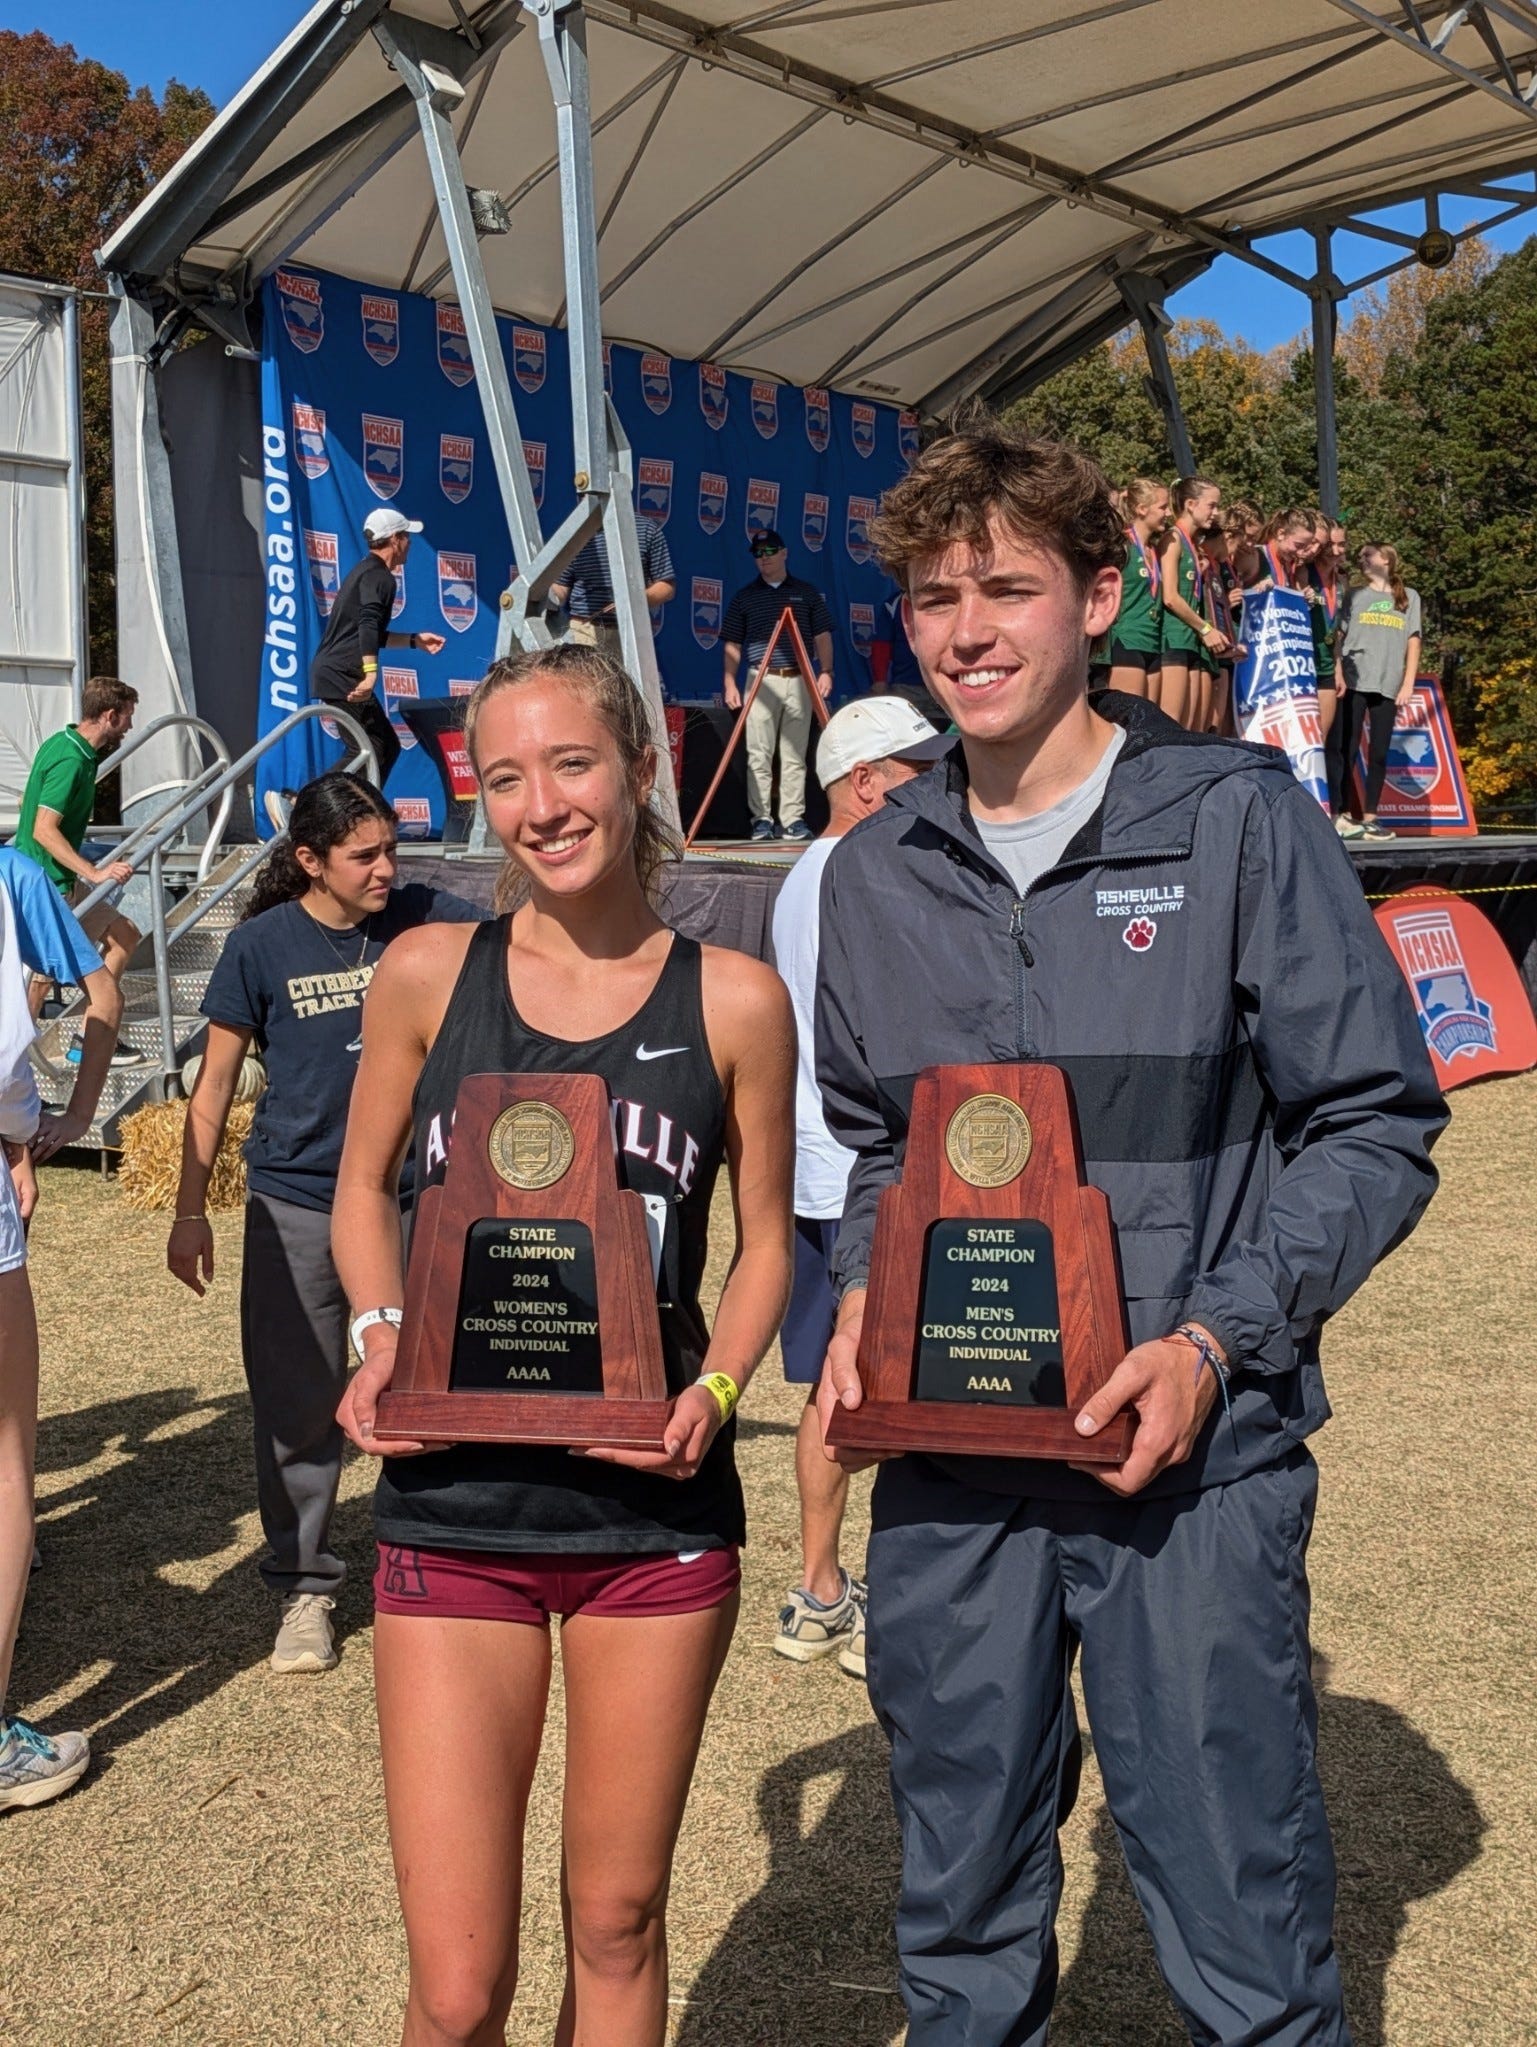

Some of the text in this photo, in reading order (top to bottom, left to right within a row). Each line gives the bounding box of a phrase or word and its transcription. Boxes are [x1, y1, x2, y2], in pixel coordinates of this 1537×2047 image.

[363, 302, 397, 320] NCHSAA
[440, 311, 467, 333] NCHS
[514, 333, 545, 350] NCHSAA
[364, 422, 402, 446] NCHSAA
[442, 440, 472, 460] NCHSAA
[640, 466, 671, 485] NCHSAA
[440, 559, 475, 580] NCHSAA
[1268, 655, 1317, 682] 2024
[384, 675, 417, 698] NCHSAA
[1096, 885, 1185, 904] ASHEVILLE
[1096, 900, 1184, 917] CROSS COUNTRY
[1401, 929, 1462, 975] NCHSAA
[288, 962, 378, 1000] CUTHBER
[293, 993, 360, 1019] TRACK
[509, 1228, 556, 1241] STATE
[967, 1229, 1015, 1243] STATE
[489, 1245, 576, 1260] CHAMPION
[947, 1247, 1035, 1263] CHAMPION
[512, 1274, 550, 1288] 2024
[971, 1278, 1009, 1292] 2024
[493, 1301, 568, 1316] WOMEN'S
[966, 1307, 1014, 1321] MEN'S
[463, 1318, 598, 1335] CROSS COUNTRY
[922, 1325, 1060, 1343] CROSS COUNTRY
[489, 1338, 570, 1352] INDIVIDUAL
[949, 1346, 1031, 1362] INDIVIDUAL
[506, 1366, 551, 1380] AAAA
[967, 1376, 1012, 1391] AAAA
